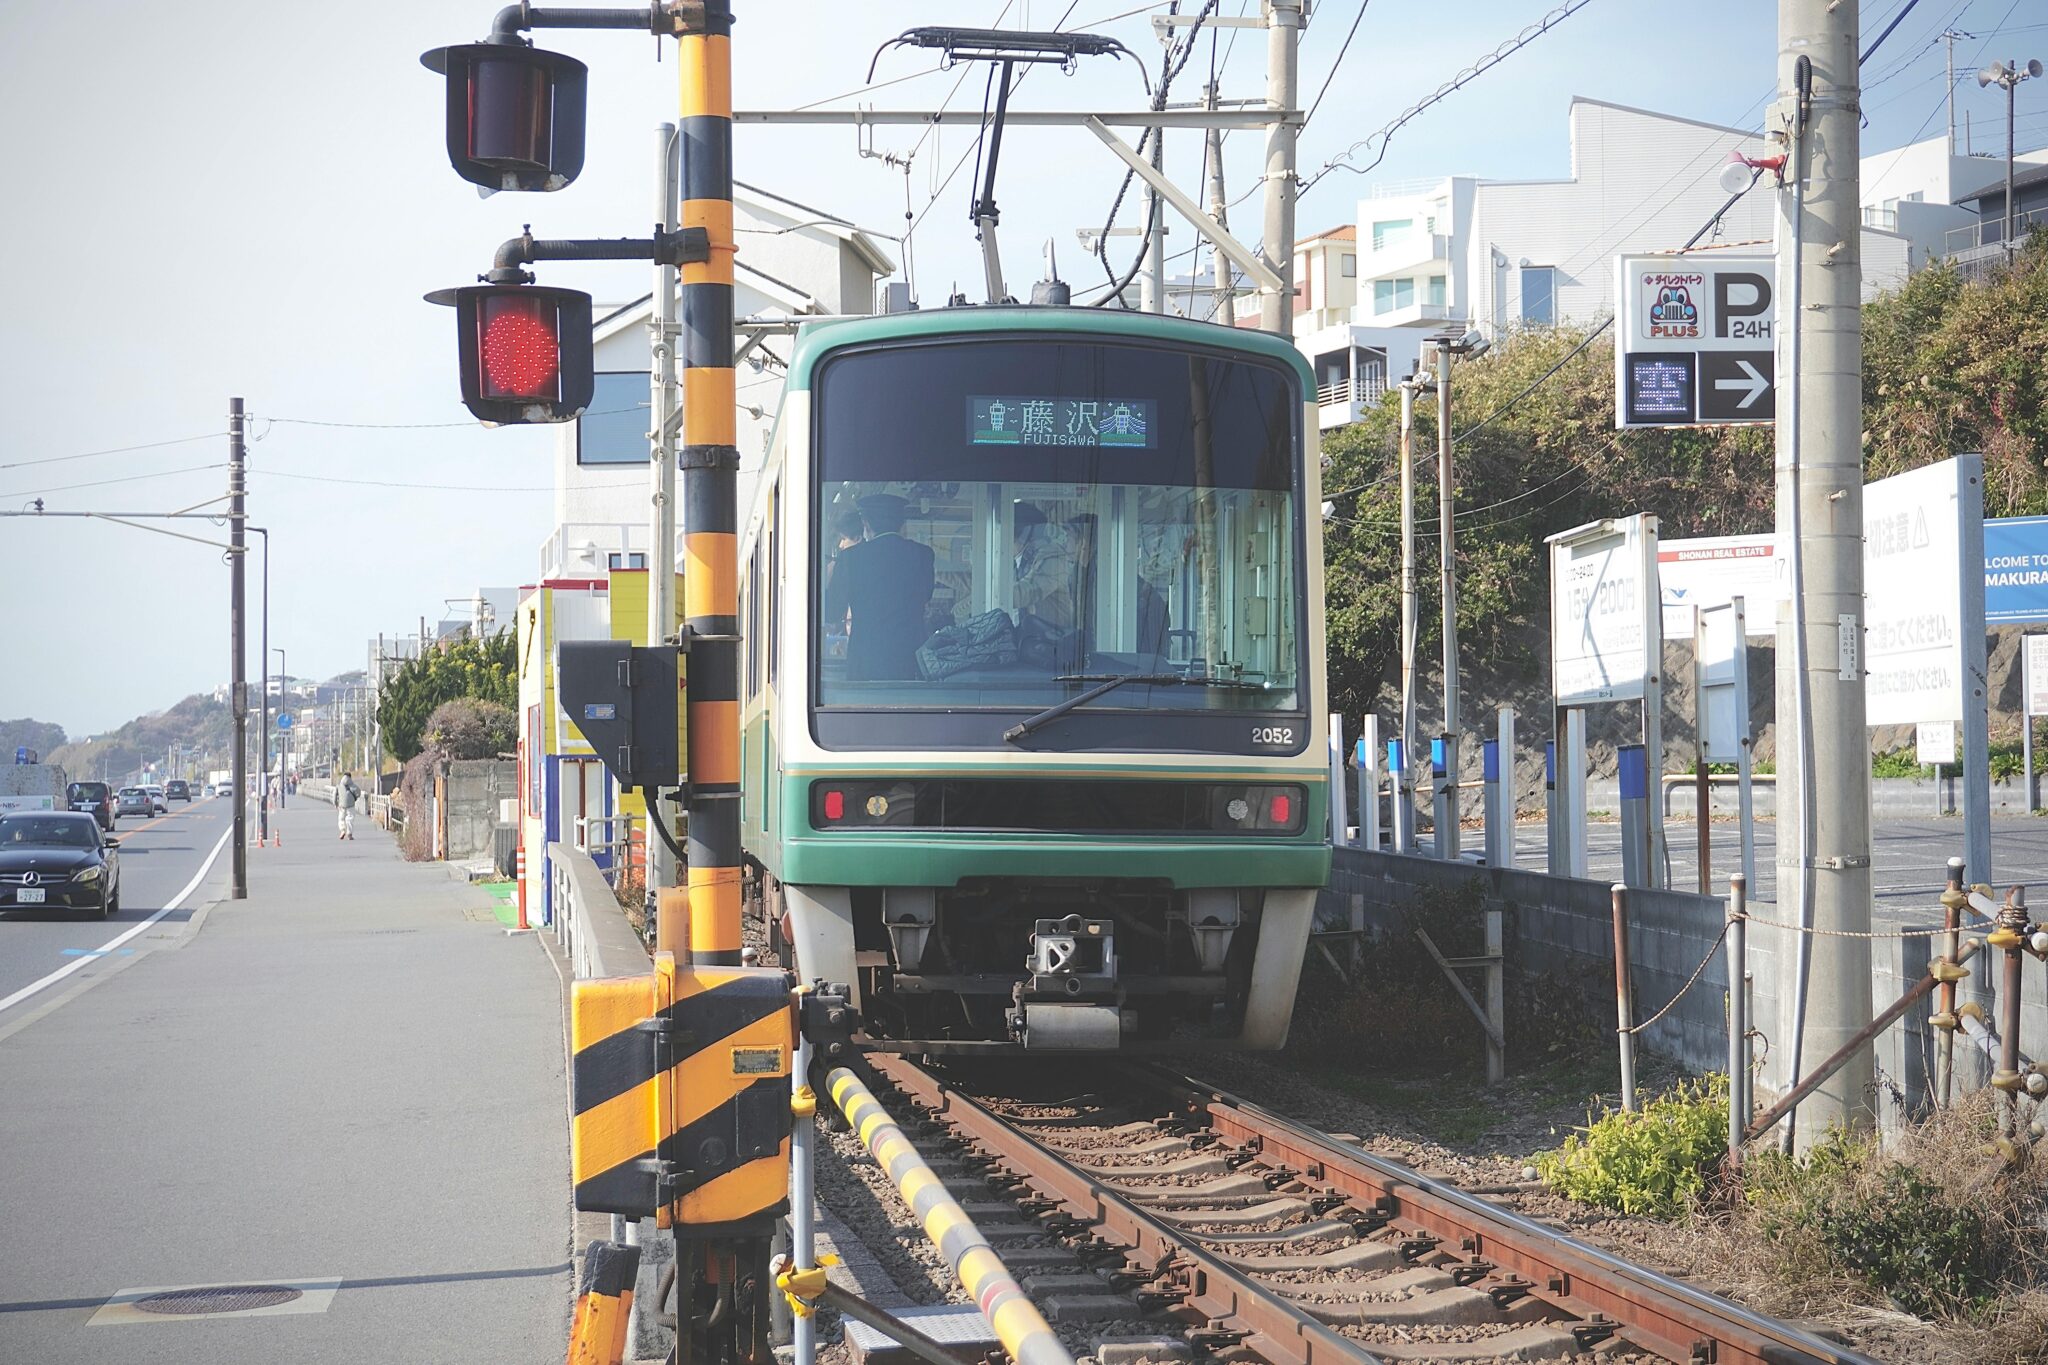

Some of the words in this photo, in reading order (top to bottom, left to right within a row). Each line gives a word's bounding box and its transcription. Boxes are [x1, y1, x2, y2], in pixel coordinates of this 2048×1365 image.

[1655, 275, 1703, 286] ダイレクトパーク
[1714, 272, 1772, 338] P
[1650, 325, 1699, 338] PLUS
[1733, 321, 1771, 339] 24H
[1020, 400, 1099, 435] 藤沢
[1023, 433, 1096, 446] FUJISAWA
[1864, 512, 1909, 561] 切注意
[1678, 550, 1712, 561] SHONAN
[1713, 548, 1735, 559] REAL
[1735, 546, 1766, 558] ESTATE
[1252, 727, 1293, 744] 2052
